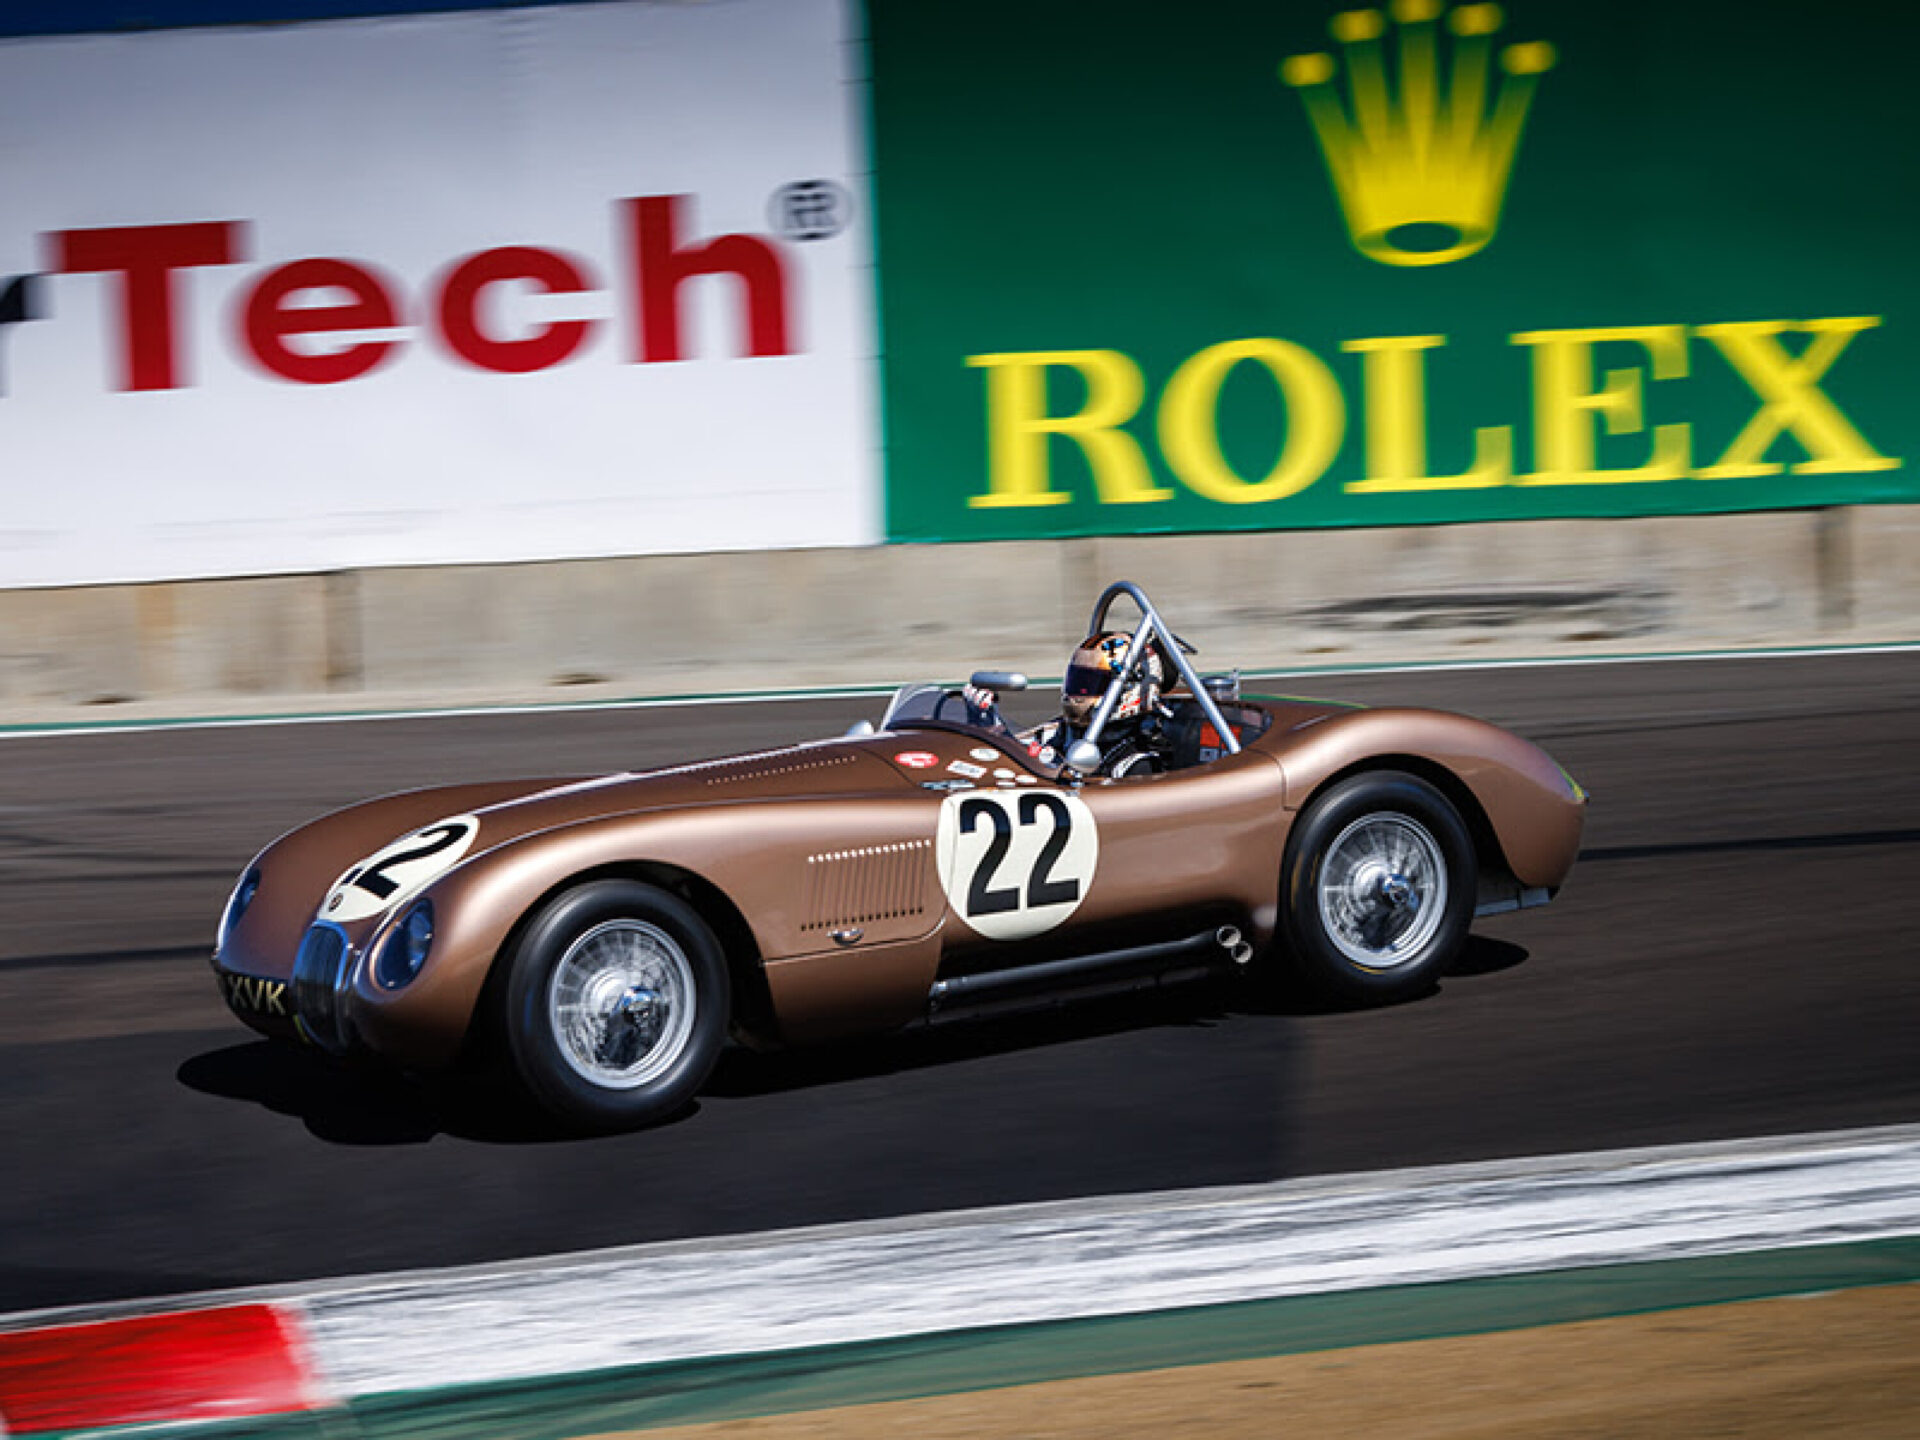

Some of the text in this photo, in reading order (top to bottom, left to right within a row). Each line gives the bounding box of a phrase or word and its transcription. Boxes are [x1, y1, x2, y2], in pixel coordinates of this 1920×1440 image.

[965, 315, 1901, 508] ROLEX
[342, 822, 469, 900] 2
[959, 793, 1080, 917] 22
